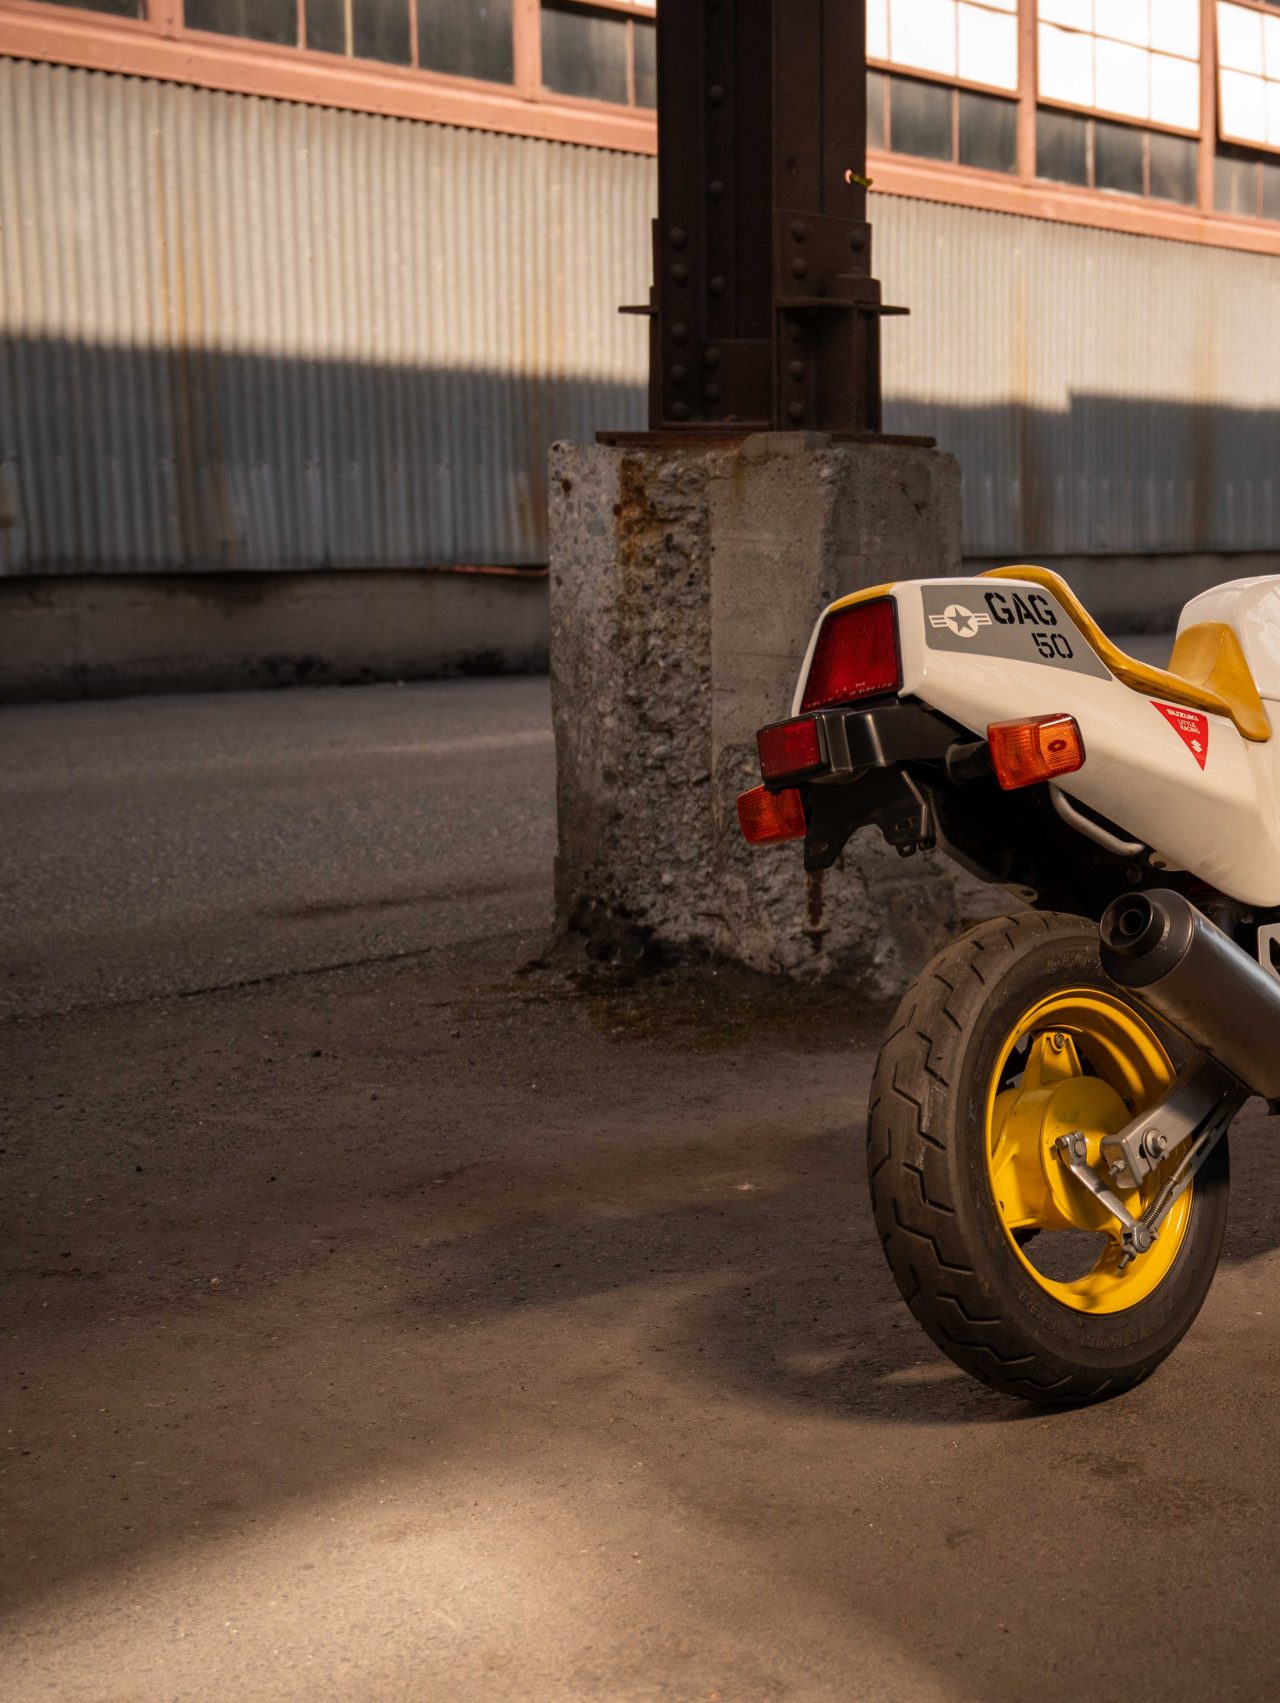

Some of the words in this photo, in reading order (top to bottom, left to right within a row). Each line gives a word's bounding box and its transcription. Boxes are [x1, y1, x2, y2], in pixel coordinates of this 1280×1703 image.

[984, 592, 1058, 626] GAG
[1032, 632, 1074, 659] 50
[1166, 709, 1199, 721] SUZUKI
[1178, 719, 1196, 727] LITTLE
[1179, 724, 1200, 734] RACING
